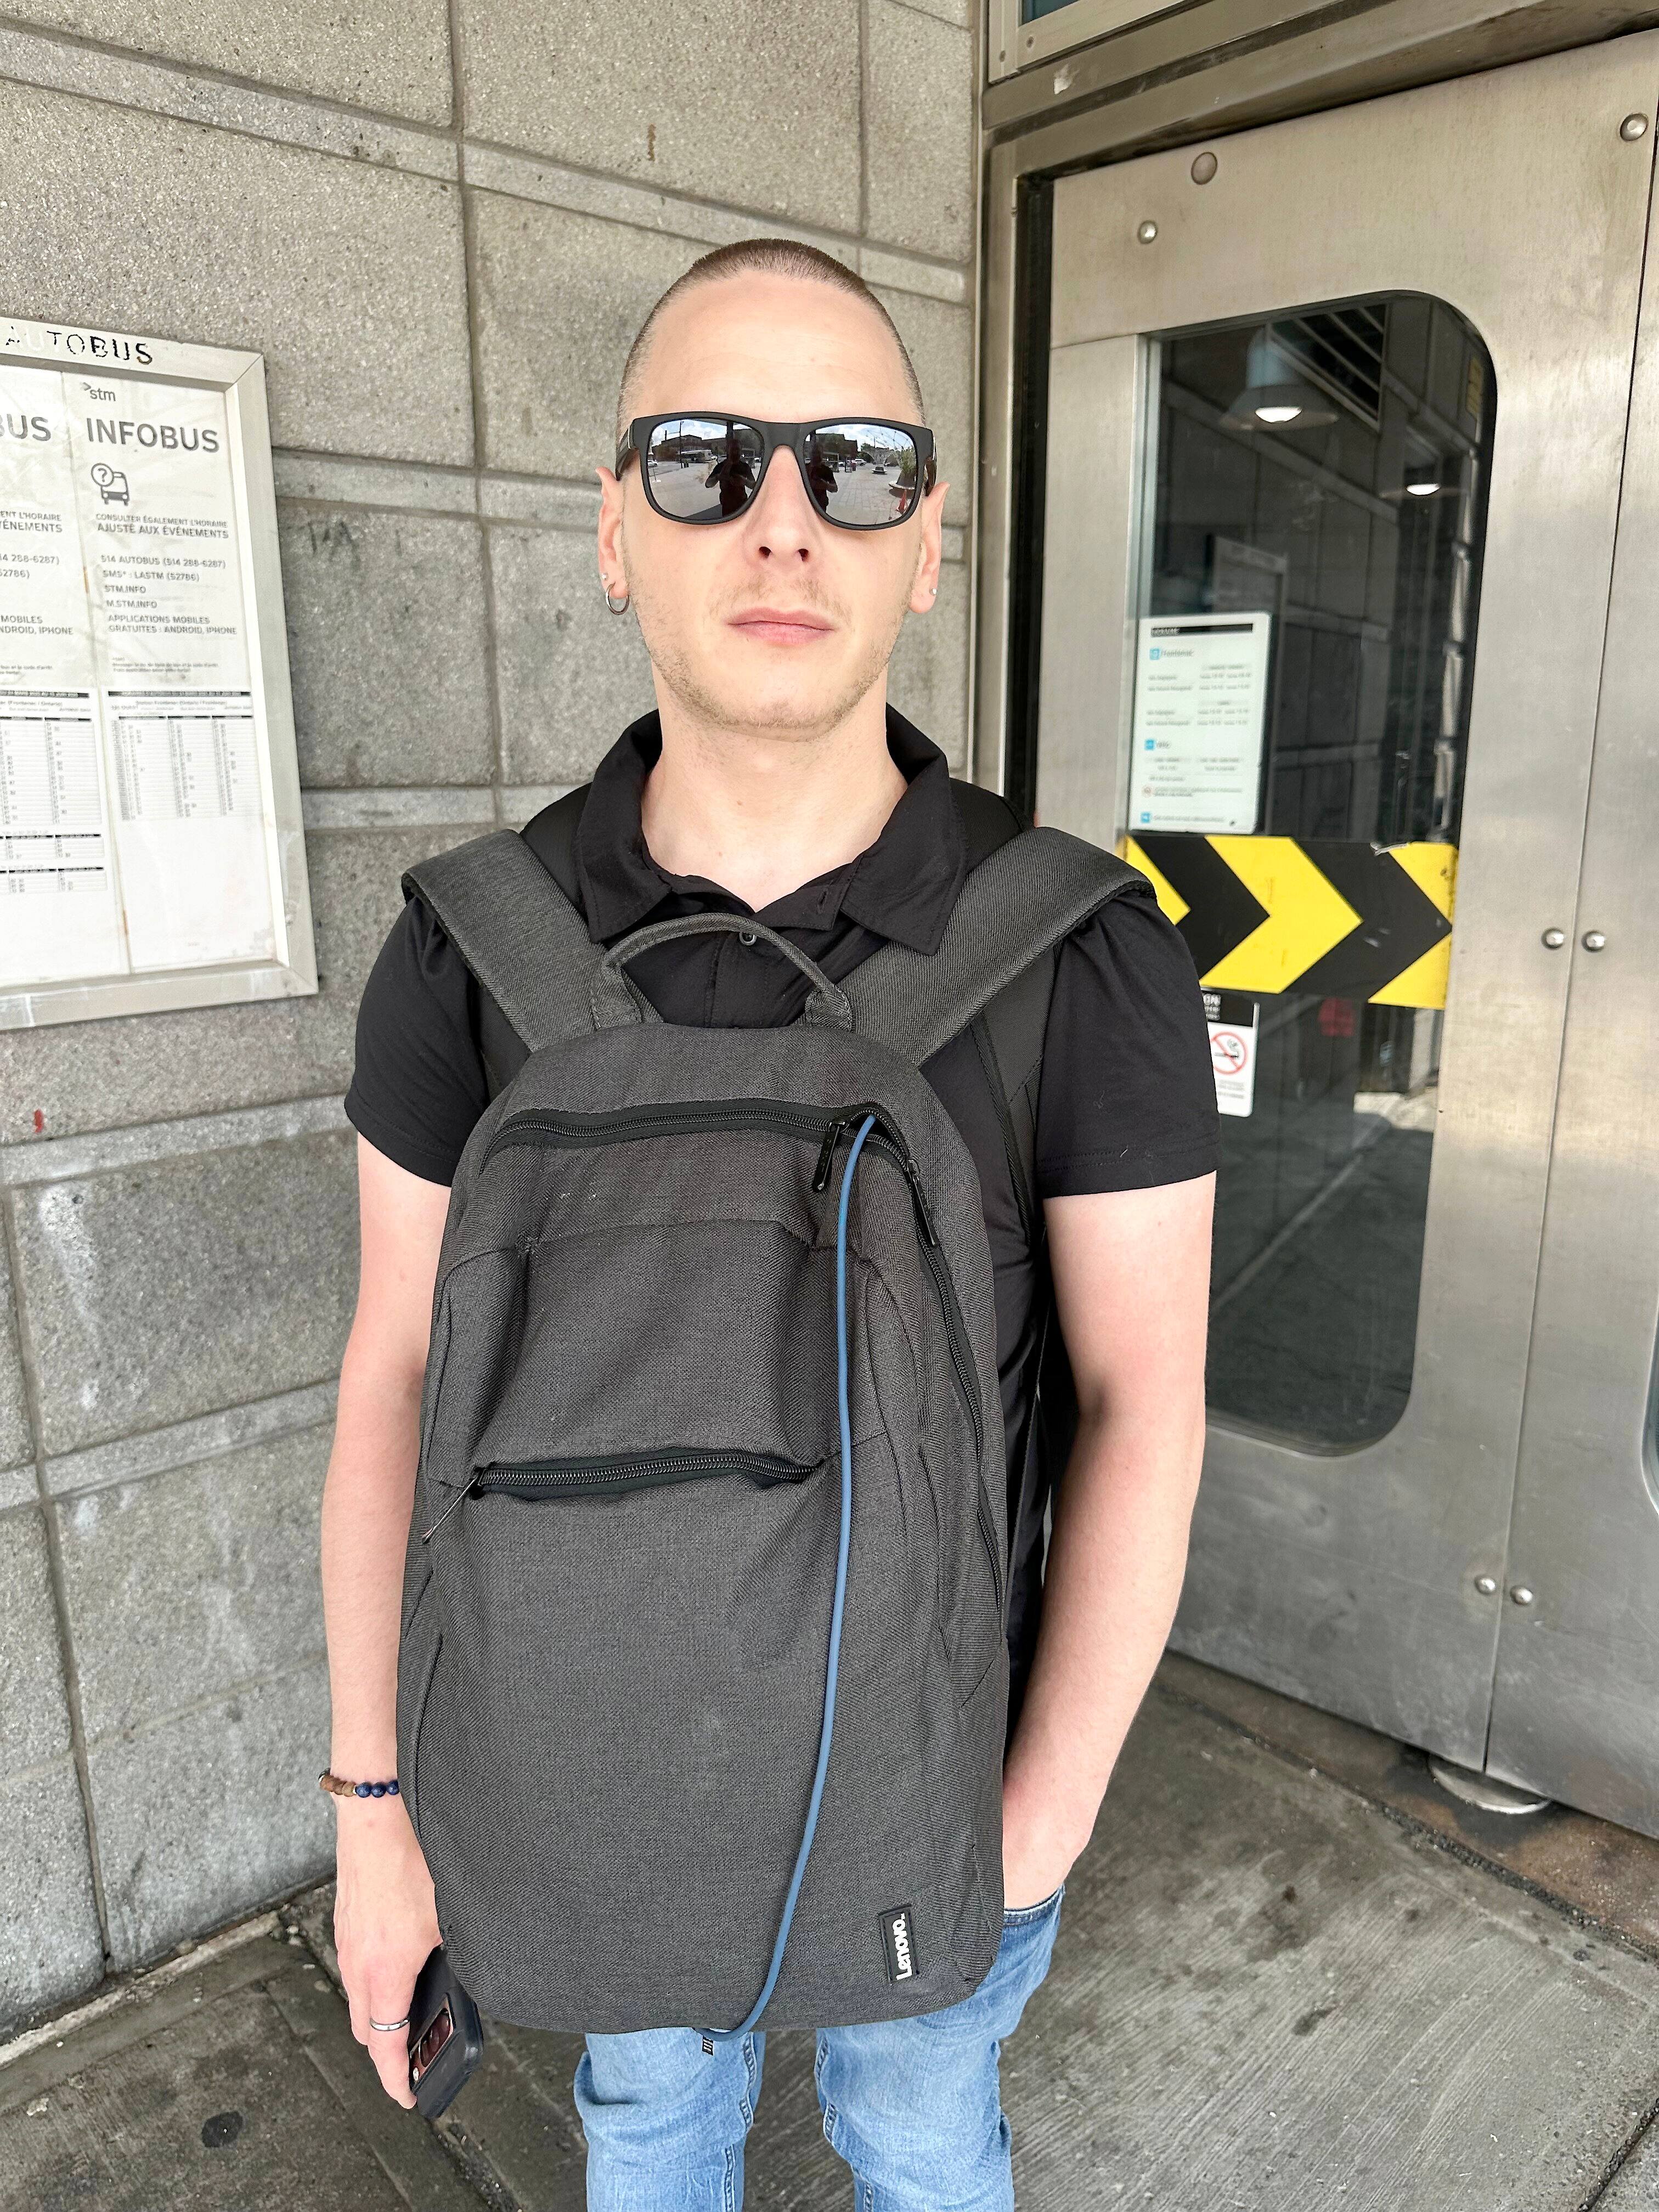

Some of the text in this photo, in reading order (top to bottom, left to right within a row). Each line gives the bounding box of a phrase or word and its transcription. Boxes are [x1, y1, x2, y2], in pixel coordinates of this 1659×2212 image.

[89, 387, 116, 402] stm
[86, 417, 220, 453] INFOBUS
[0, 519, 63, 533] ÉNEMENTS
[98, 523, 229, 539] AJUSTÉ AUX ÉVÉNEMENTS
[101, 554, 116, 563] 514
[119, 556, 160, 566] AUTOBUS
[134, 571, 165, 580] LASTM
[1, 614, 43, 624] MOBILES
[108, 614, 211, 624] APPLICATIONS MOBILES
[39, 626, 74, 635] IPHONE
[109, 625, 157, 633] GRATUITES
[206, 627, 238, 635] IPHONE
[893, 1913, 912, 1980] Lenovo
